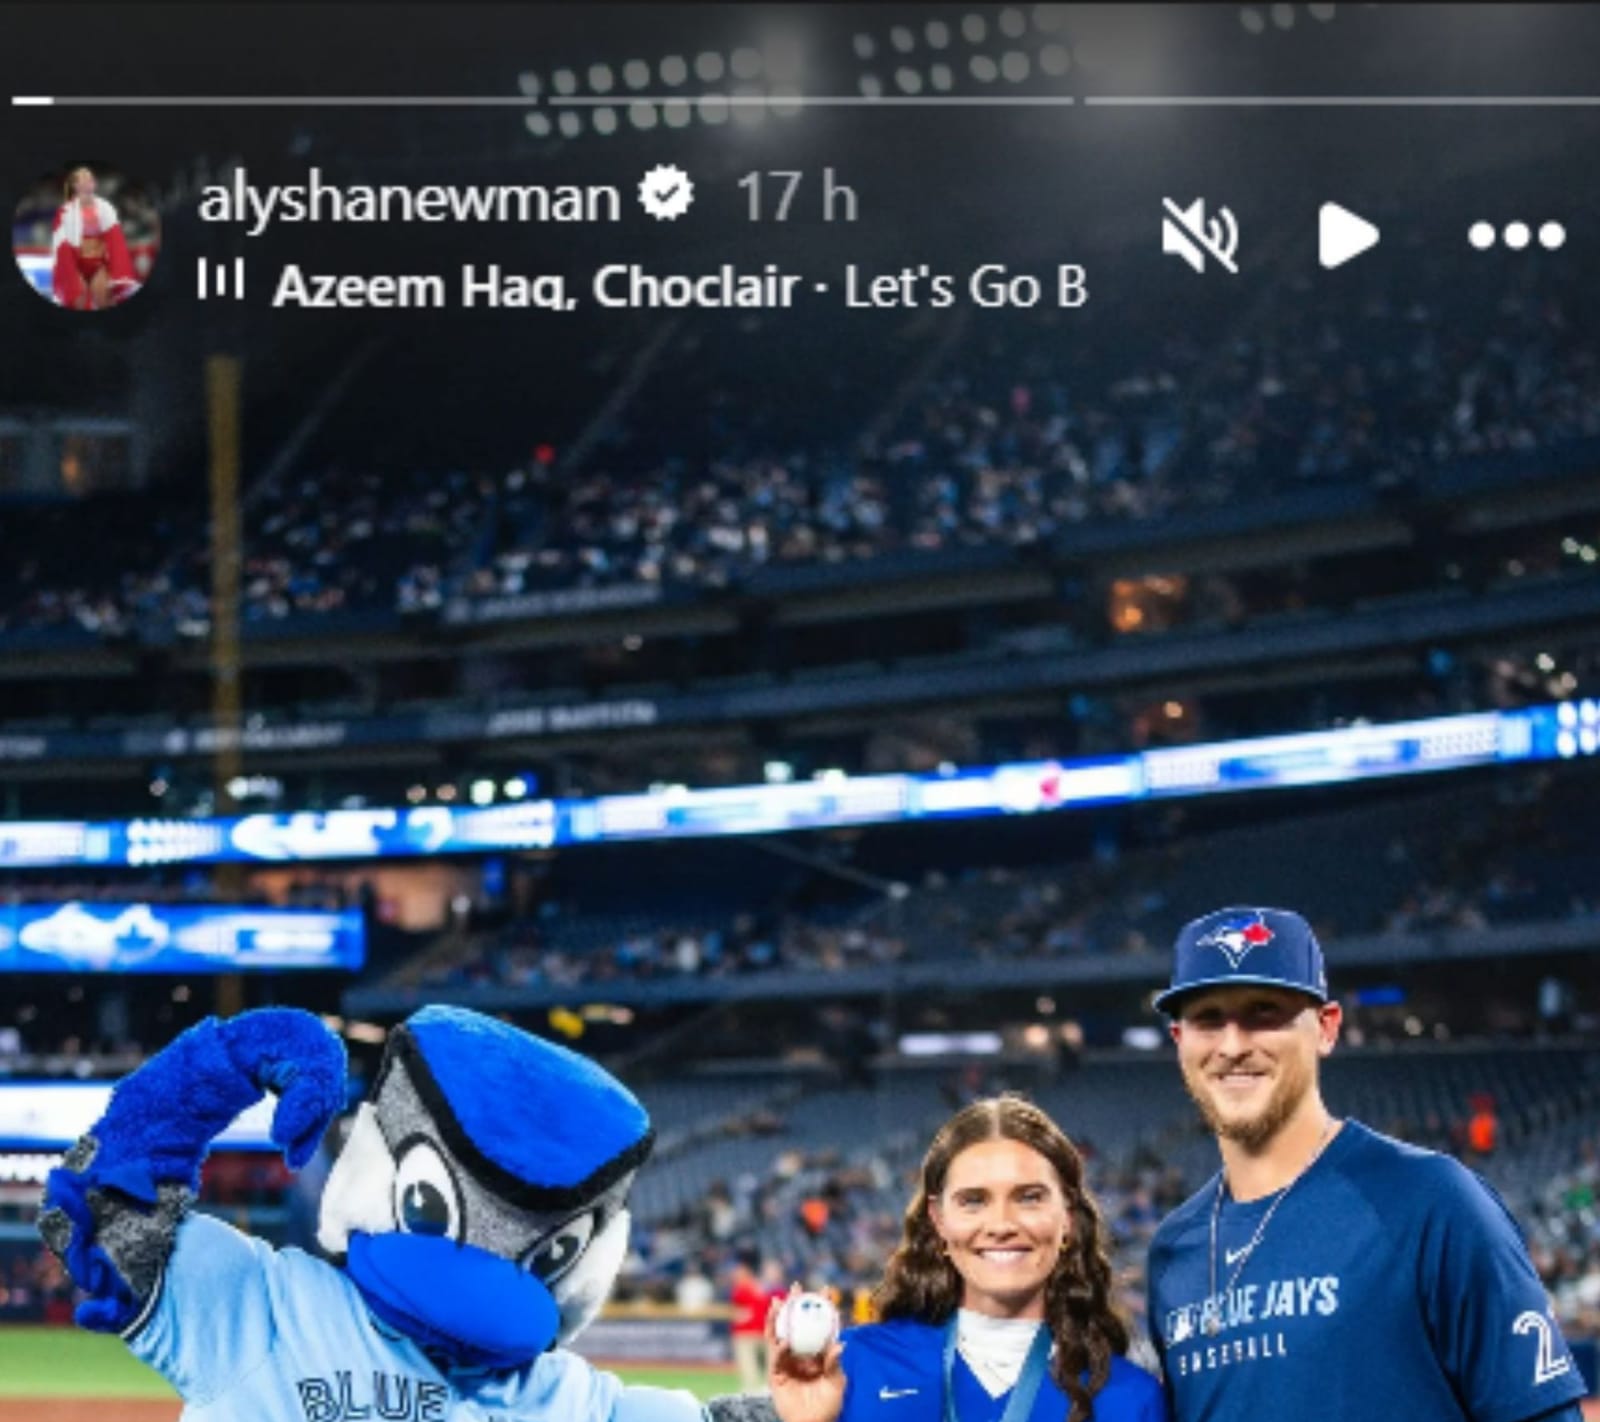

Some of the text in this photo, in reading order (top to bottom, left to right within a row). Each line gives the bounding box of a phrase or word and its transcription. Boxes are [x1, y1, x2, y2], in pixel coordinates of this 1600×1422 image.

[1200, 1274, 1339, 1336] BLUE JAYS
[1180, 1332, 1287, 1377] BASEBALL
[1512, 1310, 1572, 1386] 2
